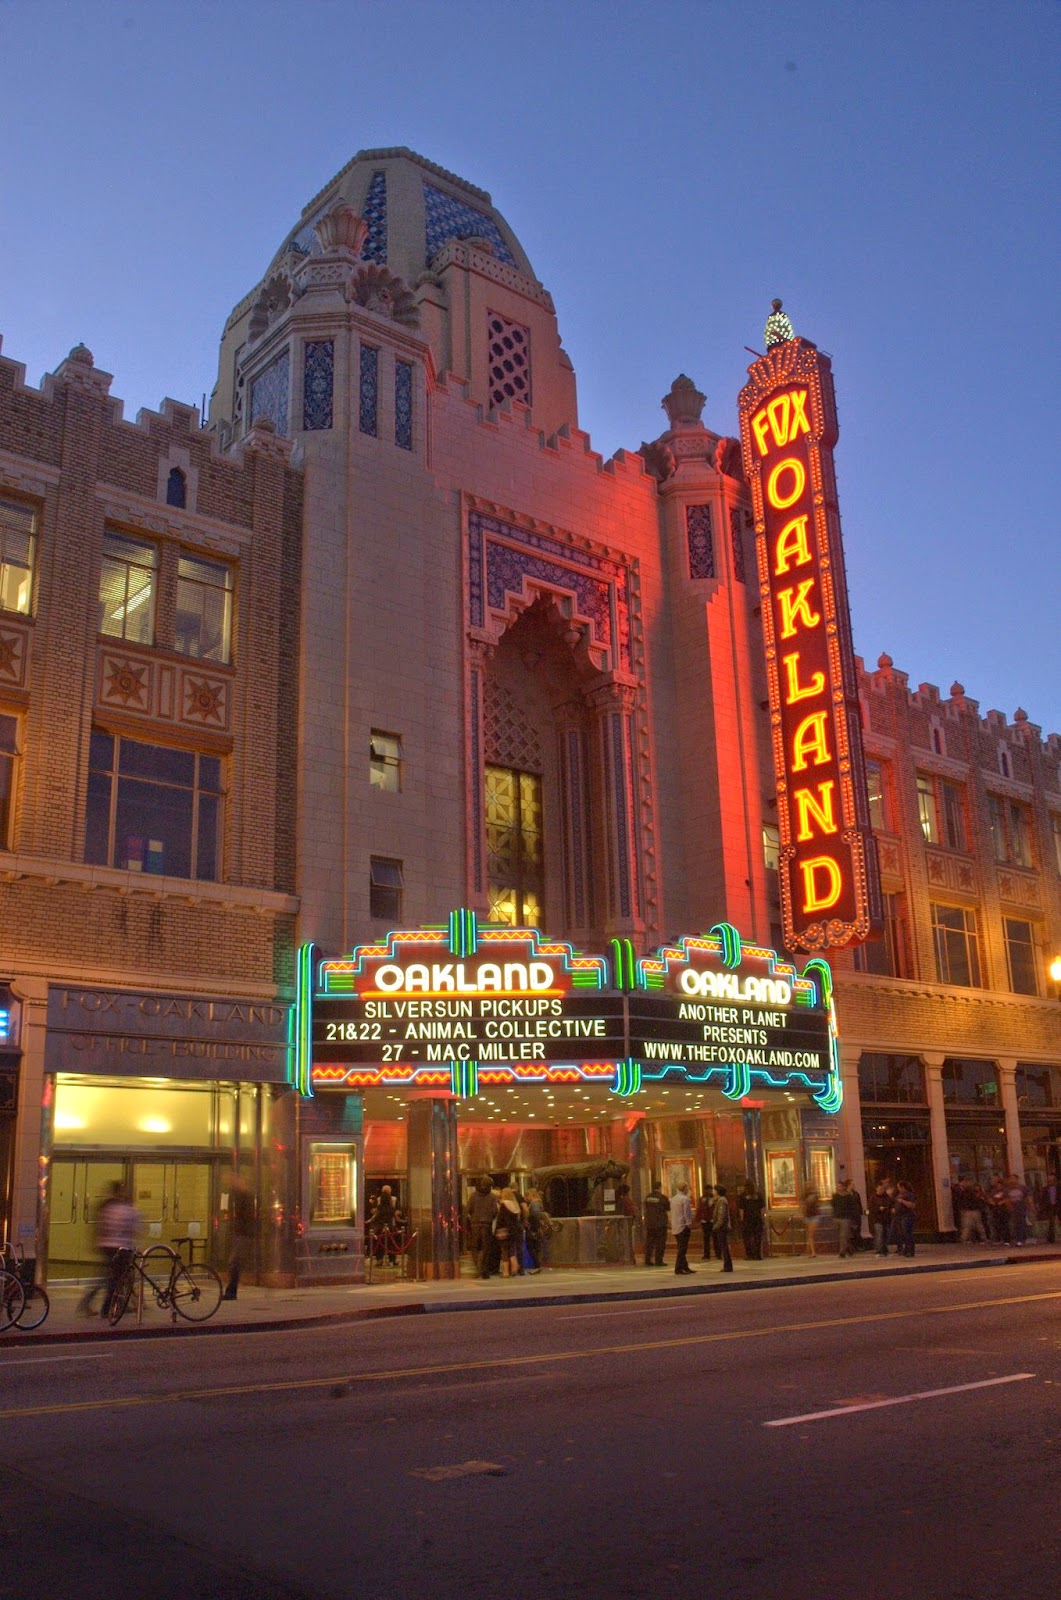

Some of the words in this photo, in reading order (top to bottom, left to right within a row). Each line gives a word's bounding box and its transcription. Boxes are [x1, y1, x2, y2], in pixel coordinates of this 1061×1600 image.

[751, 390, 811, 457] FOX
[767, 457, 843, 914] OAKLAND
[374, 962, 554, 992] OAKLAND
[680, 968, 792, 1005] OAKLAND
[364, 1000, 473, 1019] SILVERSUN
[480, 999, 563, 1017] PICKUPS
[678, 1002, 738, 1024] ANOTHER
[742, 1008, 787, 1028] PLANET
[326, 1022, 382, 1041] 21&22
[405, 1021, 477, 1040] ANIMAL
[485, 1019, 606, 1039] COLLECTIVE
[703, 1025, 768, 1046] PRESENTS
[381, 1044, 404, 1062] 27
[427, 1043, 470, 1061] MAC
[478, 1042, 546, 1060] MILLER
[644, 1042, 820, 1069] WWW.THEFOXOAKLAND.COM
